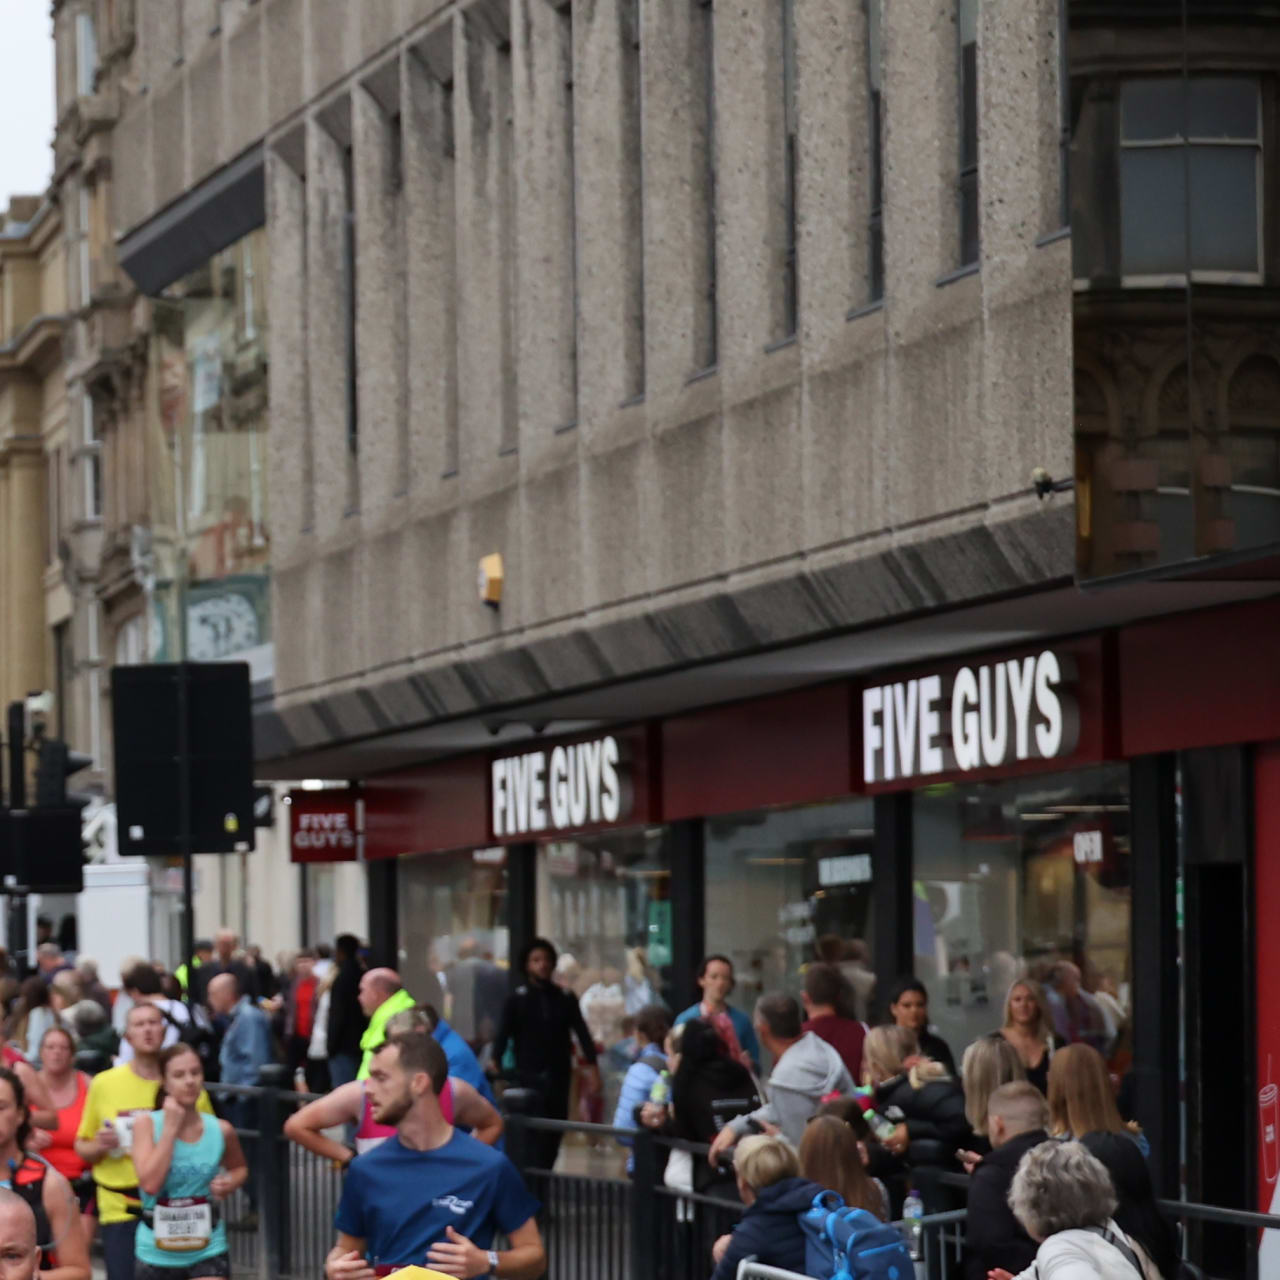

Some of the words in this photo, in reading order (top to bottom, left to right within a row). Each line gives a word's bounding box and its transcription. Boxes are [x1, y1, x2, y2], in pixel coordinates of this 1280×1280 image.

[862, 674, 944, 784] FIVE
[951, 650, 1062, 771] GUYS
[492, 751, 545, 837] FIVE
[549, 736, 620, 828] GUYS
[294, 831, 354, 847] GUYS
[299, 813, 347, 829] FIVE
